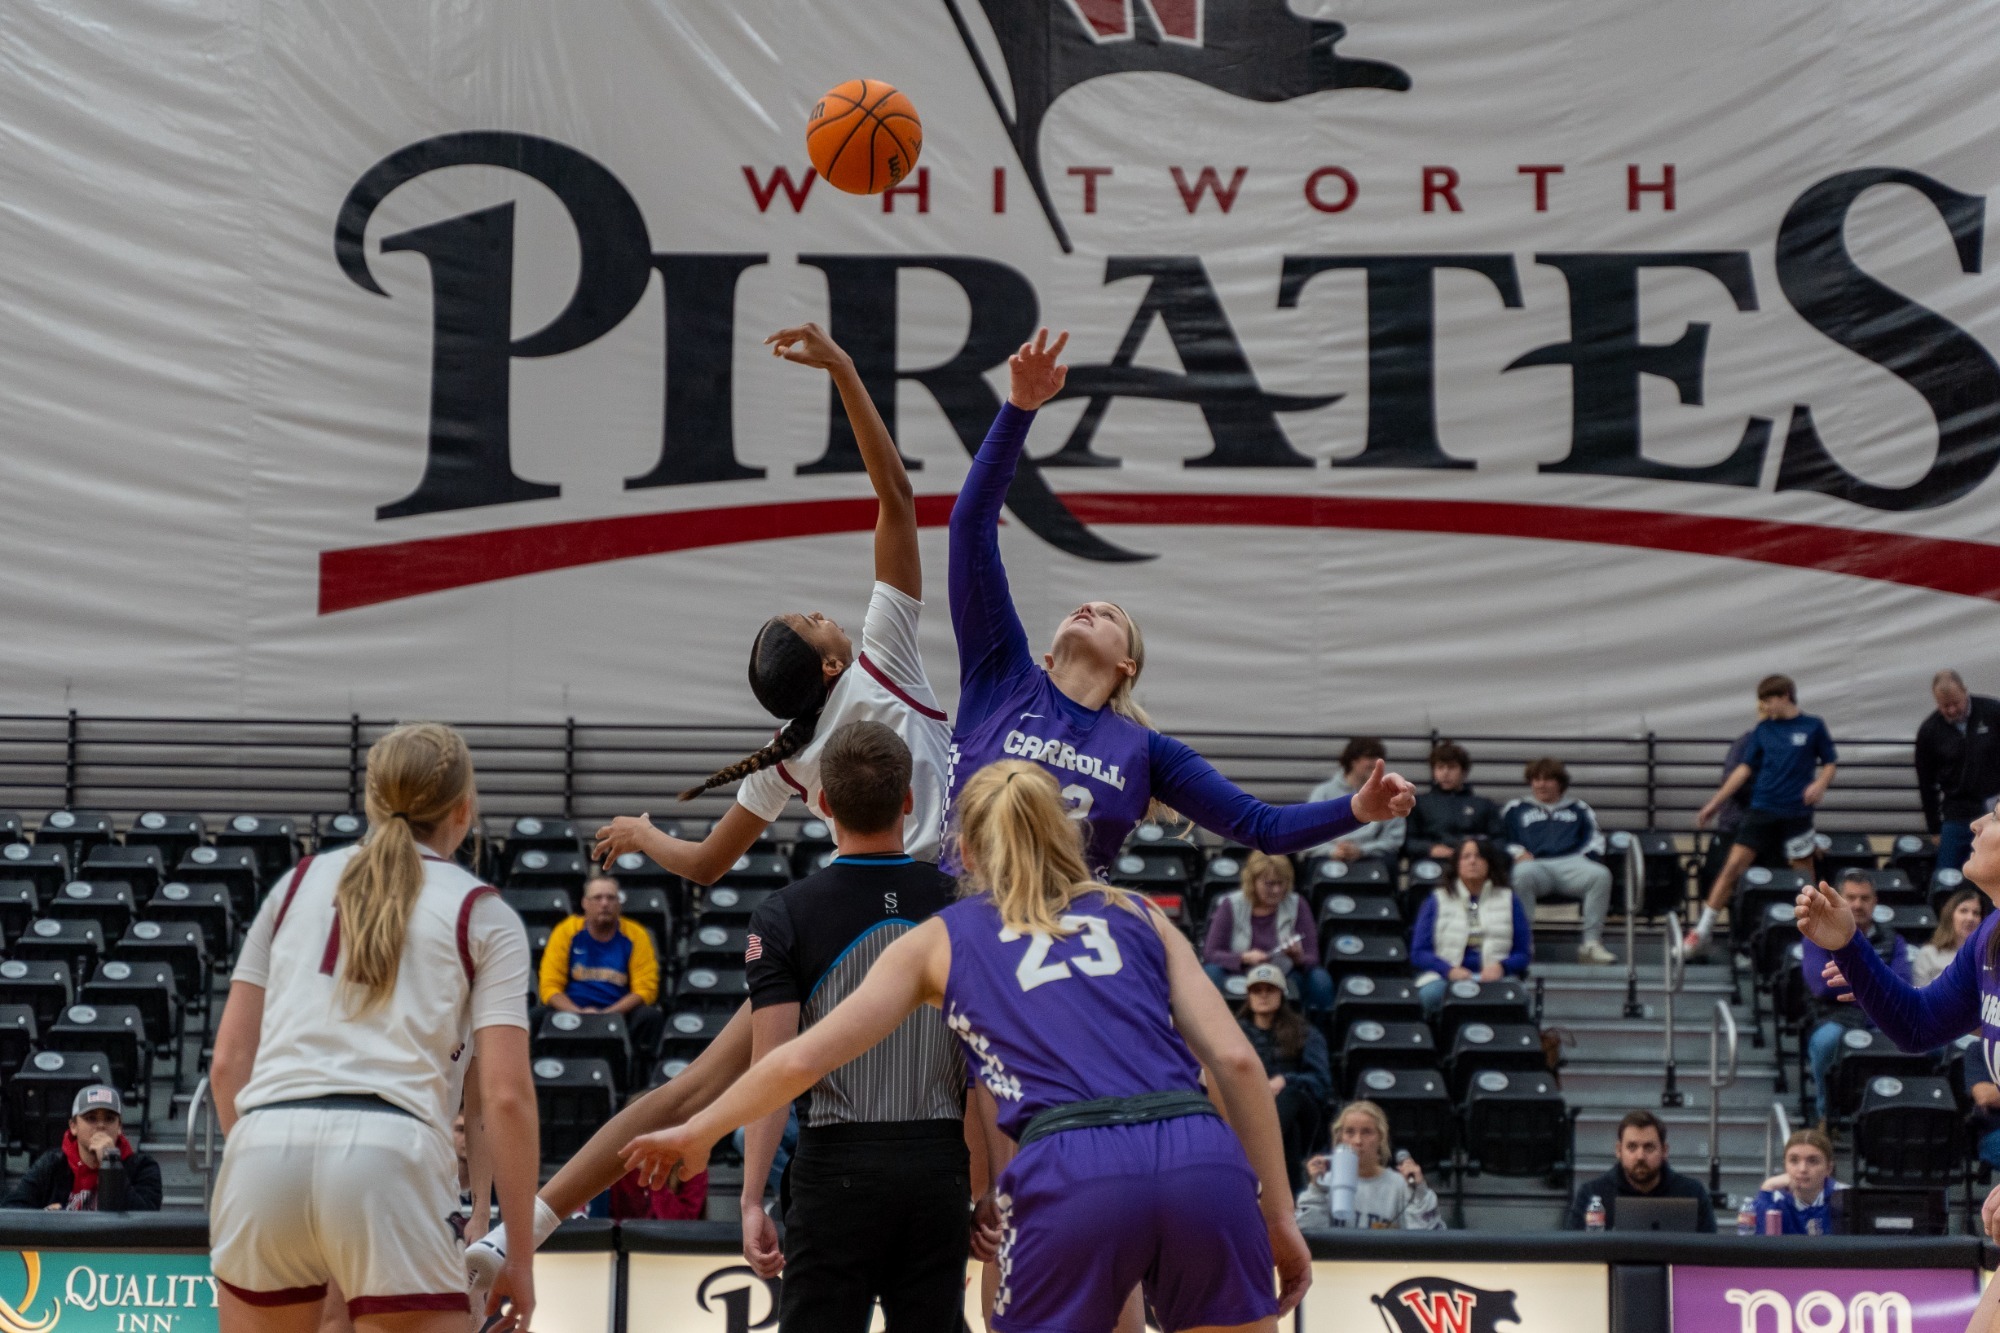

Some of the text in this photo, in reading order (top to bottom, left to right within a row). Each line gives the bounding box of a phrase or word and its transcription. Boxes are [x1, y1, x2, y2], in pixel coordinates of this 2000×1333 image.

[743, 165, 1677, 214] WHITWORTH
[334, 130, 2000, 562] PIRATES
[1003, 729, 1126, 792] CARROLL
[998, 915, 1123, 992] 23
[65, 1265, 219, 1311] QUALITY
[116, 1313, 172, 1333] INN
